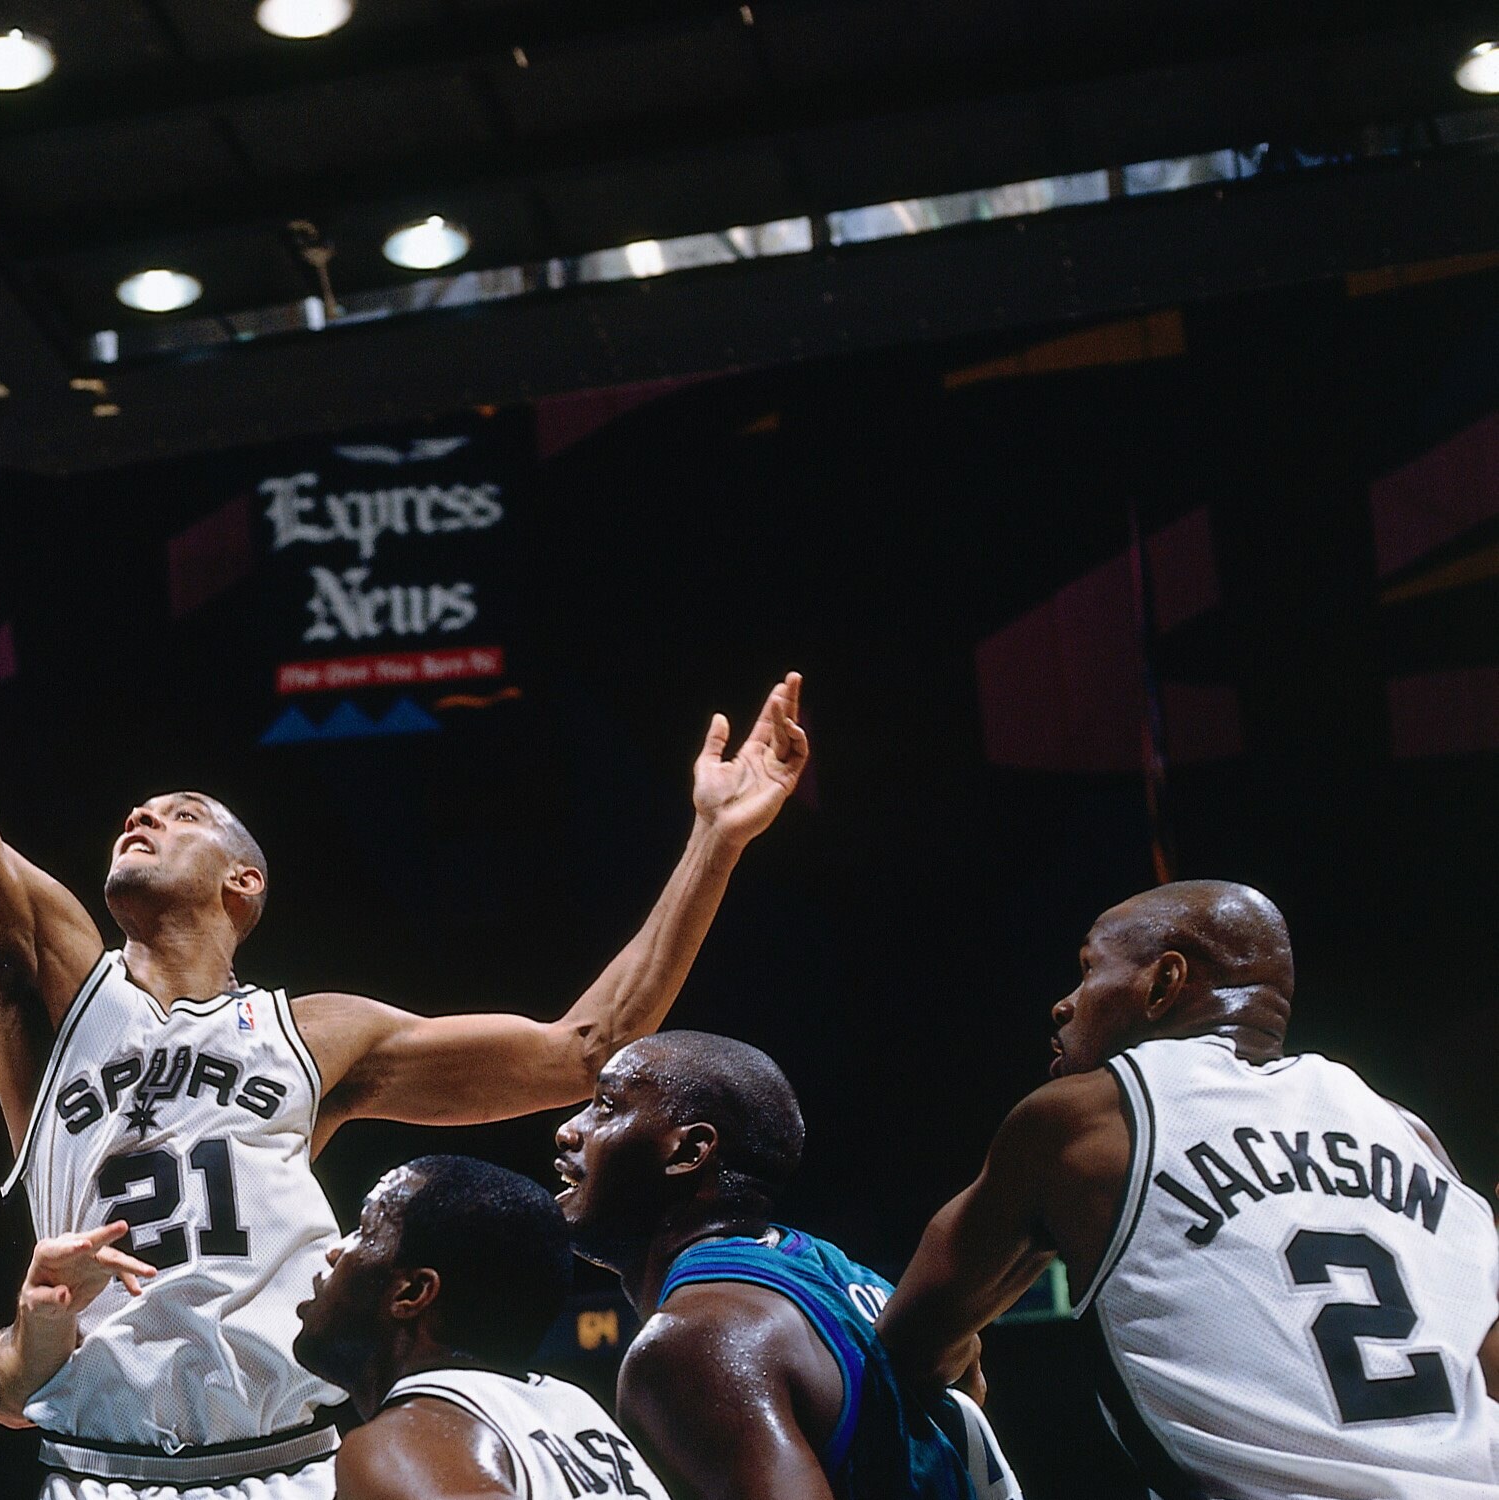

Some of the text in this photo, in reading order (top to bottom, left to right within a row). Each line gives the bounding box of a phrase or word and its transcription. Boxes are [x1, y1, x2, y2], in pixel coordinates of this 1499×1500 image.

[258, 470, 503, 558] Express
[302, 565, 478, 641] News
[55, 1045, 288, 1135] SPURS
[97, 1139, 253, 1270] 21
[1154, 1127, 1448, 1246] JACKSON
[1277, 1225, 1460, 1429] 2
